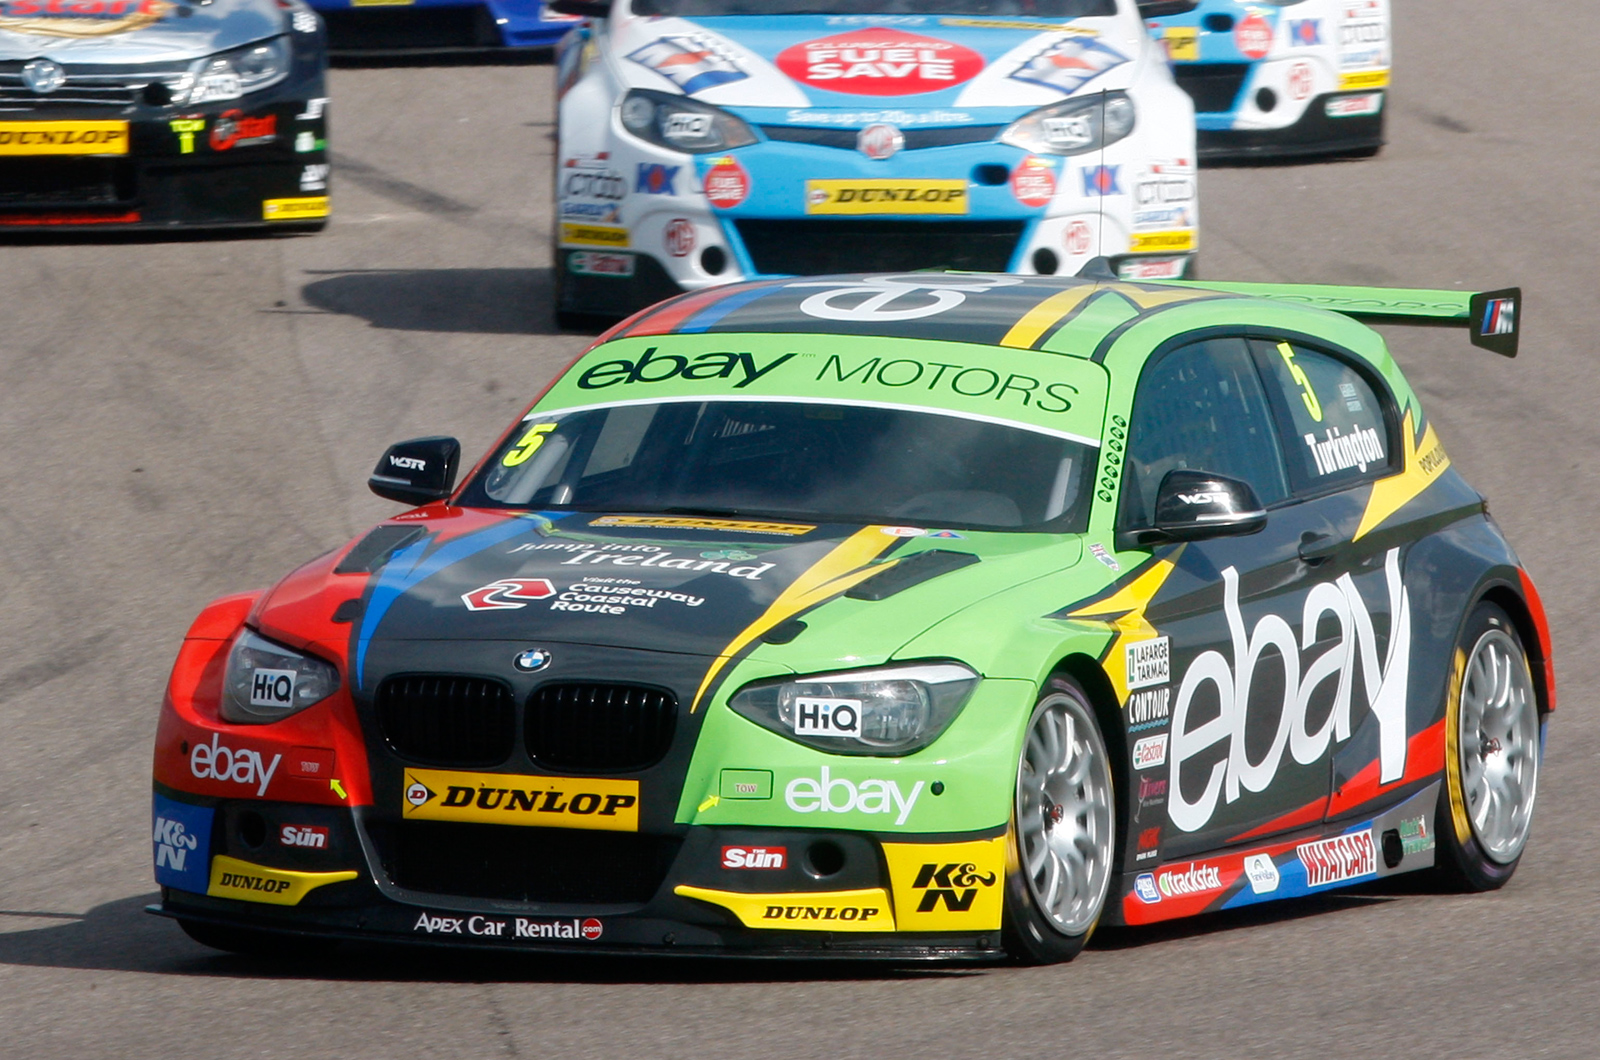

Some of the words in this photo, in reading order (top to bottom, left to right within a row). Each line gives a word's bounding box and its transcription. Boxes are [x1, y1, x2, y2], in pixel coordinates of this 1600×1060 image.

[807, 50, 955, 63] FUEL
[806, 63, 957, 80] SAVE
[833, 187, 966, 203] DUNLOP
[577, 346, 799, 390] ebay
[815, 354, 1080, 414] MOTORS
[1276, 341, 1324, 423] 5
[502, 422, 558, 467] 5
[1303, 423, 1385, 476] Turkington
[389, 455, 427, 471] WSR
[560, 549, 777, 581] Ireland
[615, 578, 642, 586] the
[558, 591, 659, 608] Coastal
[568, 583, 706, 607] Causeway
[550, 600, 626, 615] Route
[1136, 642, 1168, 663] LAFARGE
[1137, 660, 1168, 682] TARMAC
[252, 673, 292, 703] HiQ
[1167, 546, 1411, 832] ebay
[1128, 687, 1170, 724] CONTOUR
[799, 703, 858, 732] HiQ
[1141, 740, 1164, 764] Castrol
[190, 732, 283, 797] ebay
[735, 783, 758, 793] TOW
[784, 765, 926, 826] ebay
[440, 785, 637, 816] DUNLOP
[280, 826, 326, 848] Sun
[722, 848, 783, 868] Sun
[219, 872, 291, 894] DUNLOP
[1167, 862, 1223, 895] trackstar
[762, 905, 880, 921] DUNLOP
[468, 915, 506, 936] Car
